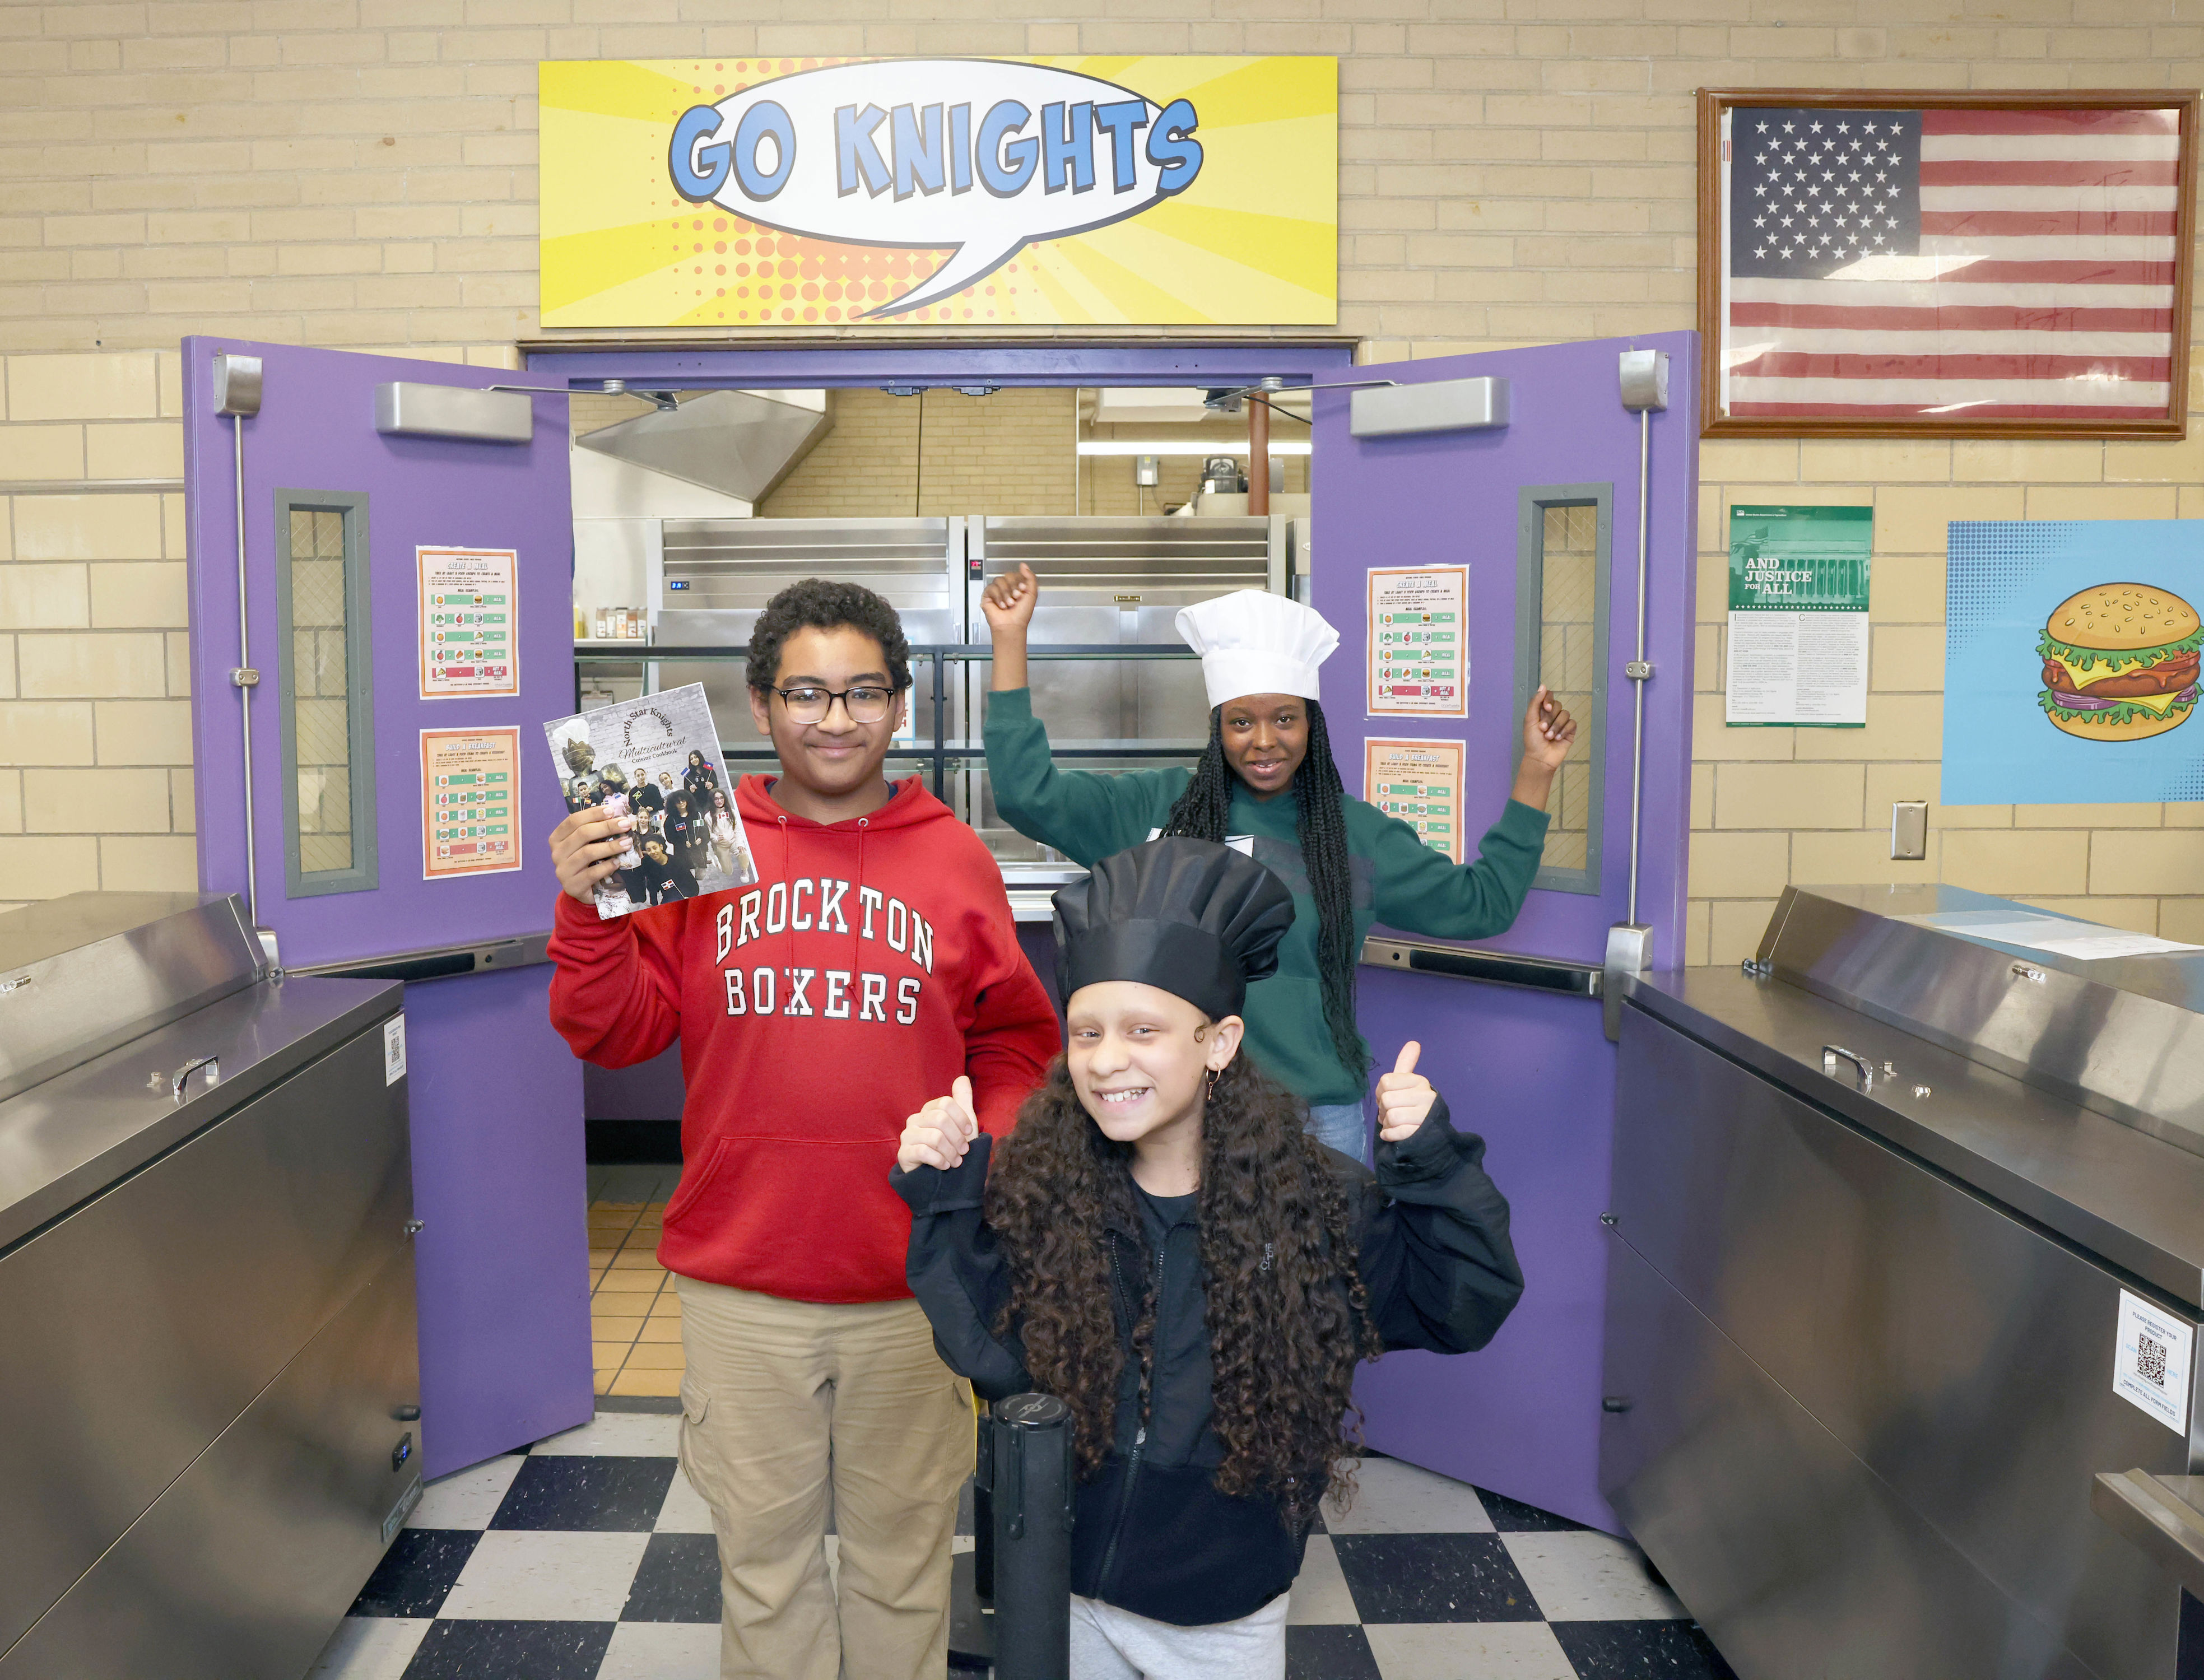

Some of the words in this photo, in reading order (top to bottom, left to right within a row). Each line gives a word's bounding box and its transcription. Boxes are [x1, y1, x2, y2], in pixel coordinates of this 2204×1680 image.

[668, 99, 796, 203] GO
[834, 97, 1205, 203] KNIGHTS
[1745, 558, 1780, 569] AND
[1745, 570, 1812, 582] JUSTICE
[1762, 583, 1793, 594] ALL
[624, 720, 633, 747] North
[629, 709, 648, 720] Star
[650, 708, 673, 737] Knights
[619, 736, 686, 760] Multicultural
[652, 748, 678, 758] Cookbook
[715, 877, 934, 978] BROCKTON
[724, 966, 922, 1026] BOXERS
[2132, 1311, 2147, 1324] PLEASE
[2147, 1320, 2166, 1335] REGISTER
[2166, 1331, 2177, 1341] YOUR
[2145, 1326, 2163, 1339] PRODUCT
[2126, 1343, 2137, 1353] SCAN
[2167, 1369, 2178, 1379] HERE
[2123, 1379, 2143, 1395] COMPLETE
[2151, 1397, 2161, 1407] FORM
[2162, 1404, 2175, 1416] FIELDS
